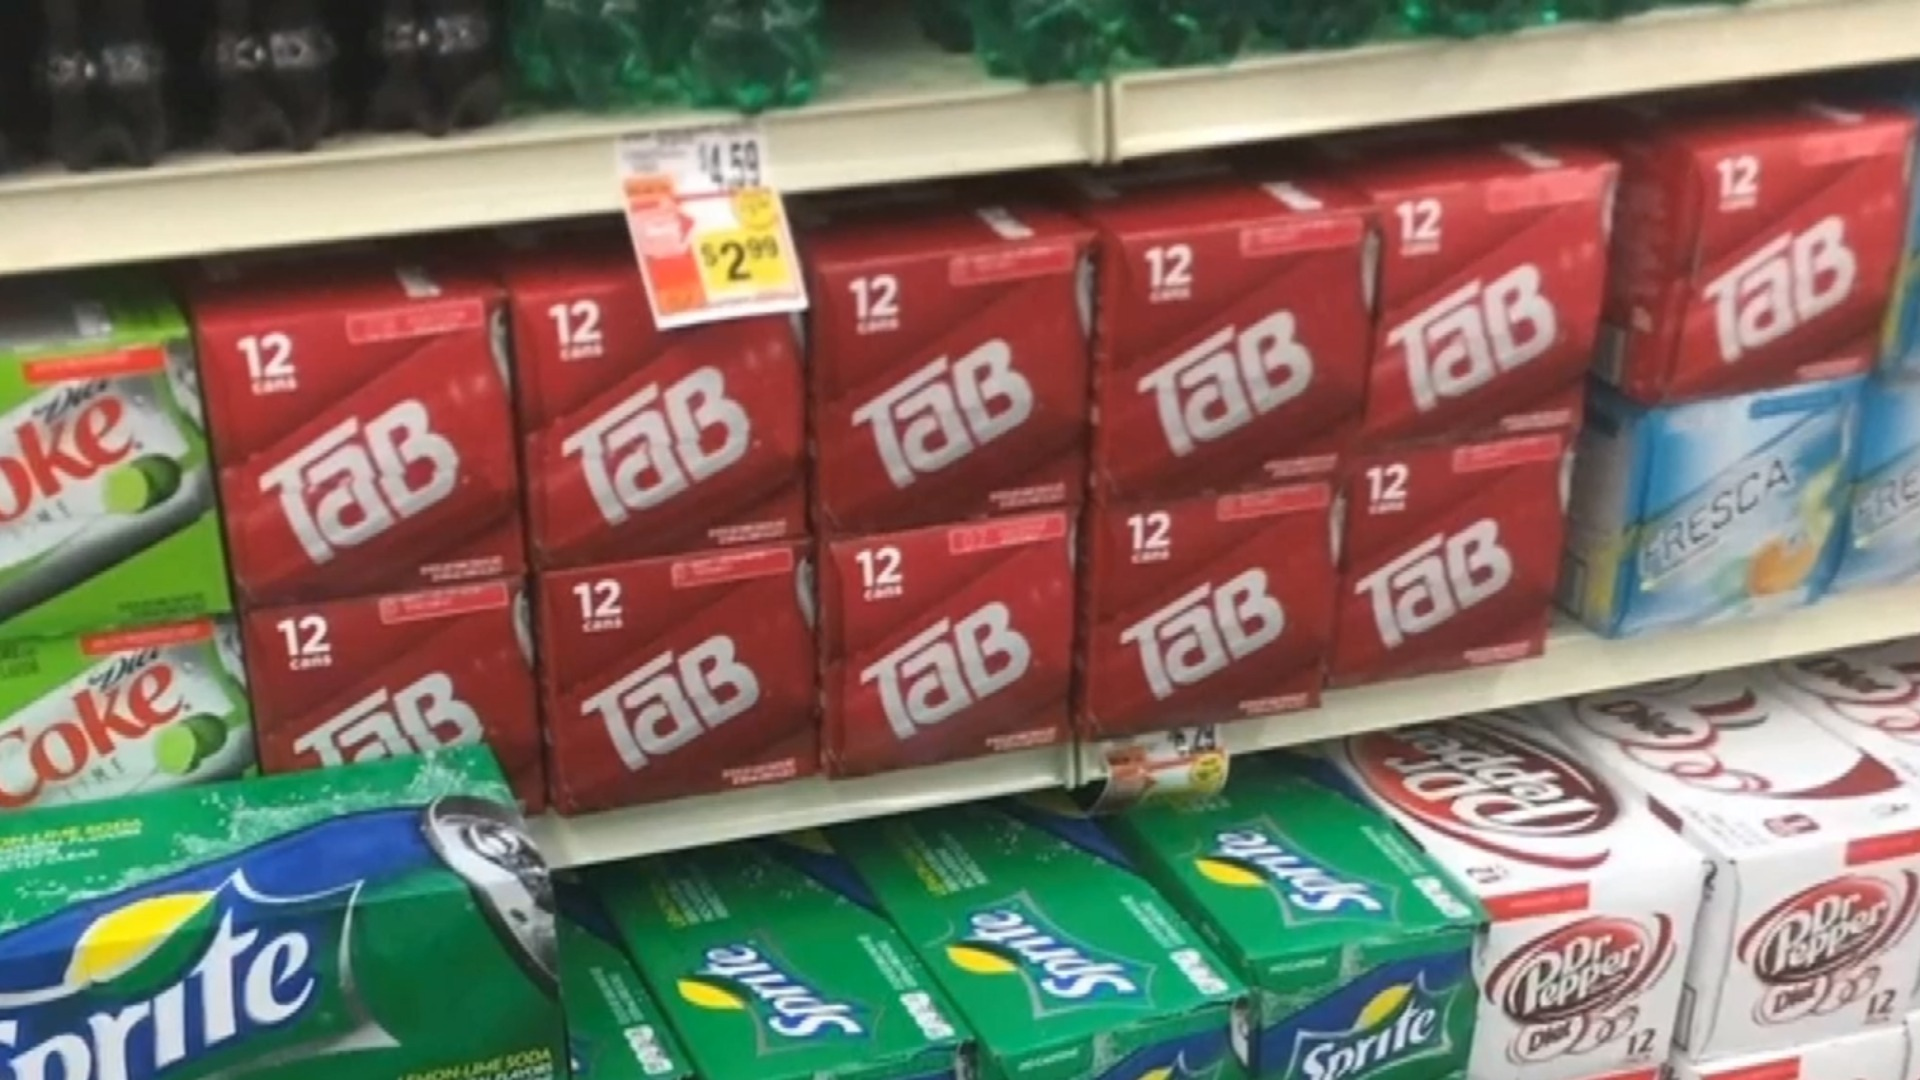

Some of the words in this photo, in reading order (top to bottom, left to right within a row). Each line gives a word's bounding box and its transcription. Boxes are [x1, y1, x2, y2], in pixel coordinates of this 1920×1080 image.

[1717, 155, 1759, 197] 12
[1396, 198, 1441, 241] 12
[1145, 244, 1192, 287] 12
[849, 274, 898, 318] 12
[549, 300, 602, 343] 12
[237, 332, 295, 377] 12
[0, 395, 135, 523] oke
[1367, 463, 1408, 501] 12
[1127, 512, 1171, 550] 12
[856, 547, 902, 587] 12
[573, 578, 622, 619] 12
[277, 615, 331, 656] 12
[1217, 829, 1383, 912] Sprite
[1813, 893, 1862, 931] Dr
[970, 908, 1137, 998] Sprite
[1561, 935, 1613, 977] Dr
[1772, 901, 1888, 977] Pepper
[706, 943, 864, 1037] Sprite
[1522, 943, 1641, 1016] Pepper
[1866, 989, 1897, 1016] 12
[1302, 998, 1437, 1080] Sprite
[1627, 1027, 1656, 1056] 12
